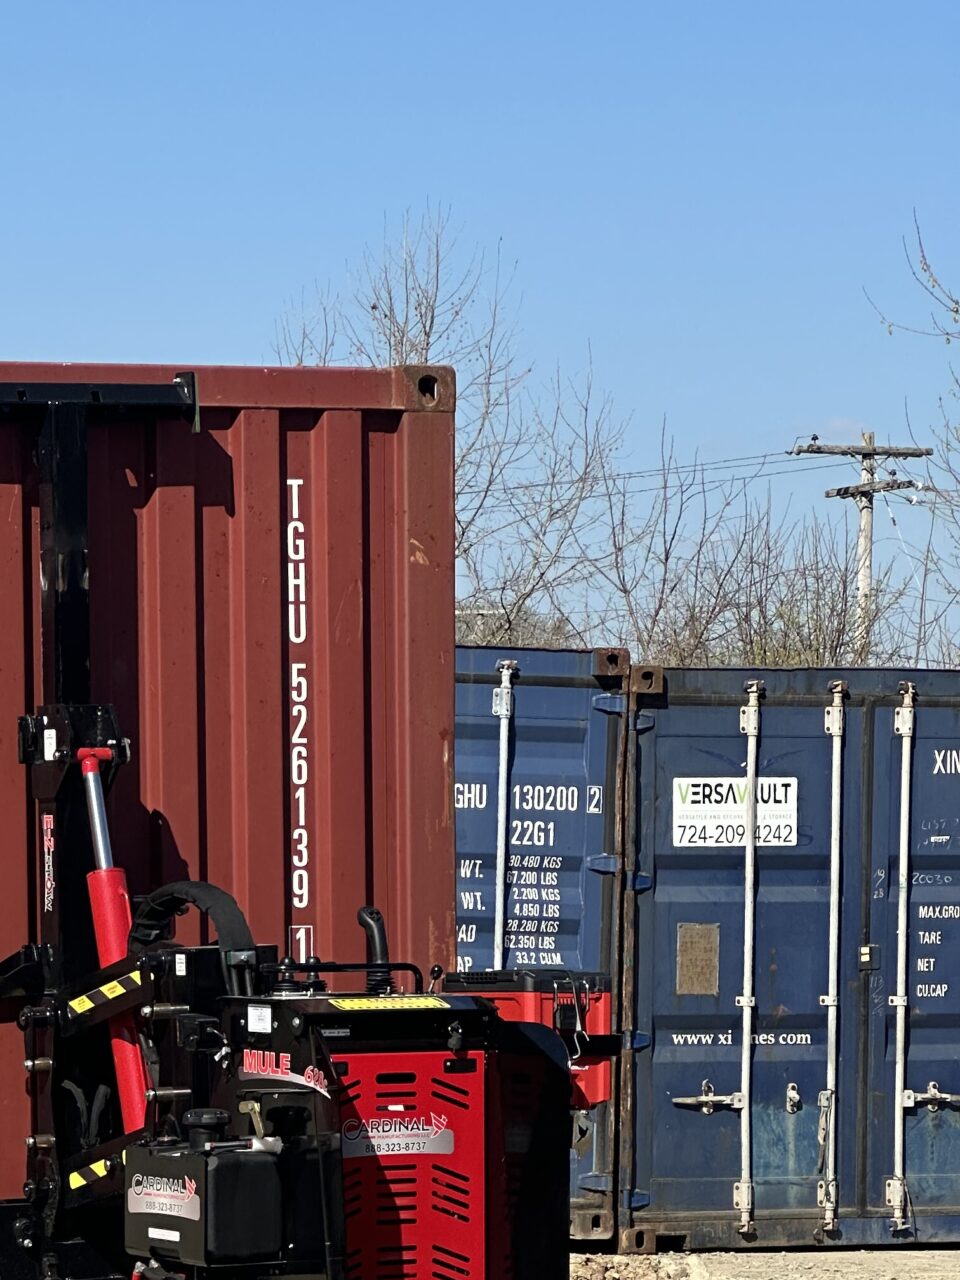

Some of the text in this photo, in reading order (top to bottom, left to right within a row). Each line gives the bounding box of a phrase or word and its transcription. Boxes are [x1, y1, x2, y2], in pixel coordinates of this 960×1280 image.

[286, 478, 308, 643] TGHU
[290, 663, 310, 908] 526139
[512, 785, 578, 811] 130200
[590, 787, 600, 812] 2
[678, 783, 792, 805] VERSAVULT
[511, 820, 555, 847] 22G1
[677, 824, 793, 844] 724-2094242
[508, 855, 562, 869] 30.480 KGS
[506, 870, 558, 886] 67.200 LBS
[513, 888, 561, 901] 2.200 KGS
[513, 904, 560, 918] 4.850 LBS
[506, 919, 560, 933] 28.280 KGS
[504, 934, 556, 950] 62.350 LBS
[918, 931, 942, 945] TARE
[516, 952, 537, 965] 33.2
[917, 958, 935, 972] NET
[917, 983, 948, 998] CU.CAP
[243, 1049, 291, 1076] MULE
[342, 1117, 430, 1142] CARDINAL
[365, 1141, 427, 1153] 888-323-8737
[132, 1173, 185, 1196] CARDINAL
